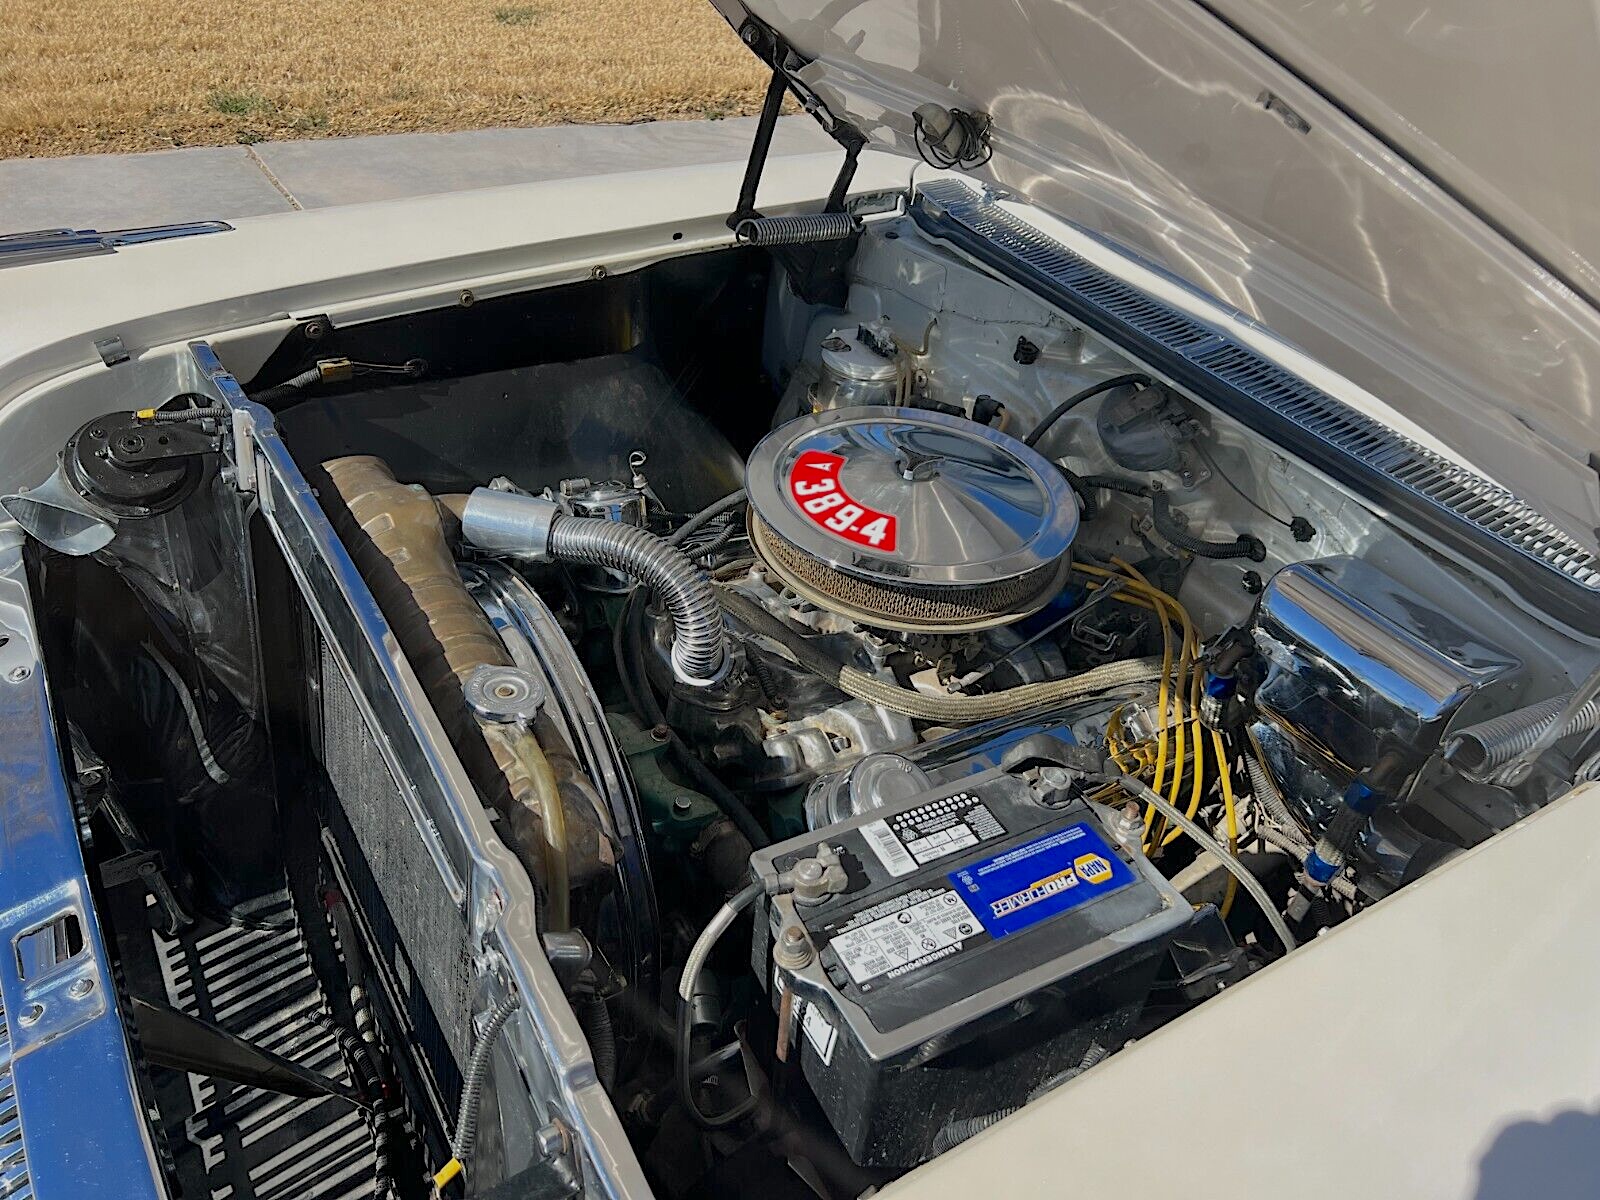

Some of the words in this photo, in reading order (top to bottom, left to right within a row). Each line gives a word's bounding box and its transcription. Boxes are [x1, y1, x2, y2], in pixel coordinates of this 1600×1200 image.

[1080, 858, 1107, 877] NAPA
[990, 872, 1080, 918] PROFORMER
[887, 947, 956, 979] DANGER/POISON
